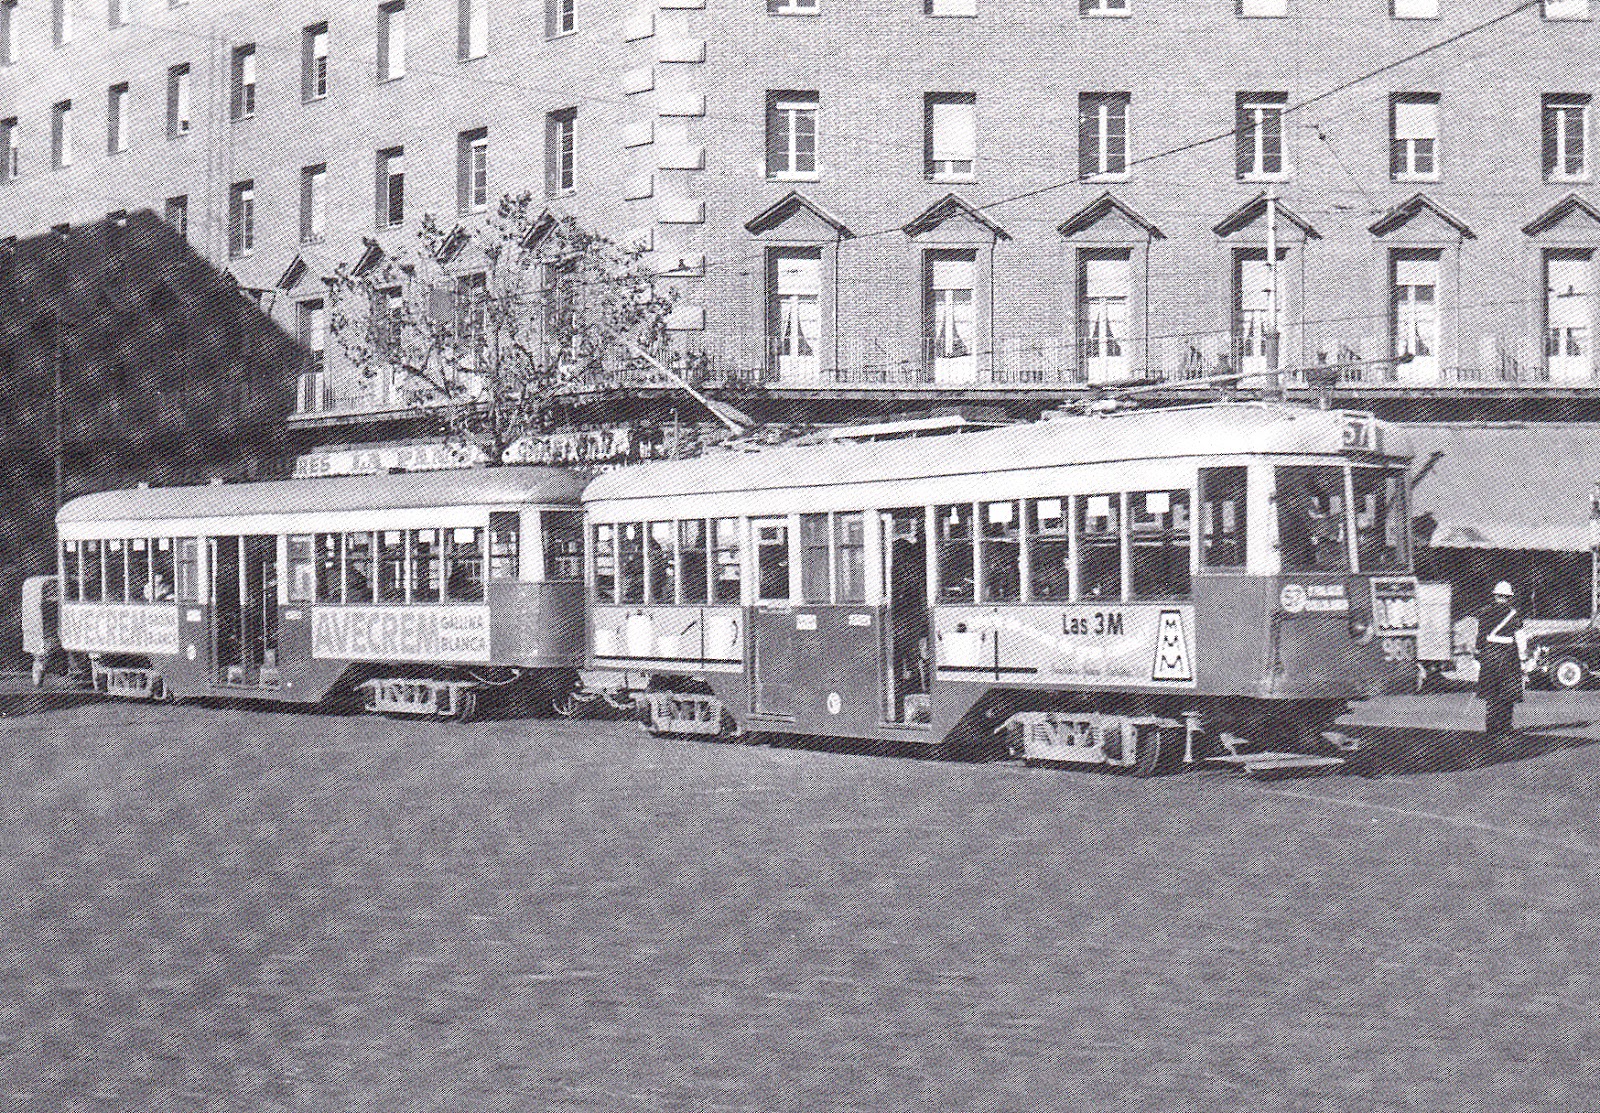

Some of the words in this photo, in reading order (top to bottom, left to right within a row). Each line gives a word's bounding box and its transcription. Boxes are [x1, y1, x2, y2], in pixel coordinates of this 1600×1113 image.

[440, 614, 484, 630] GALLINA
[1062, 613, 1088, 635] Las
[1094, 611, 1124, 635] 3M
[314, 611, 440, 654] AVECREM
[440, 636, 486, 652] BLANCA
